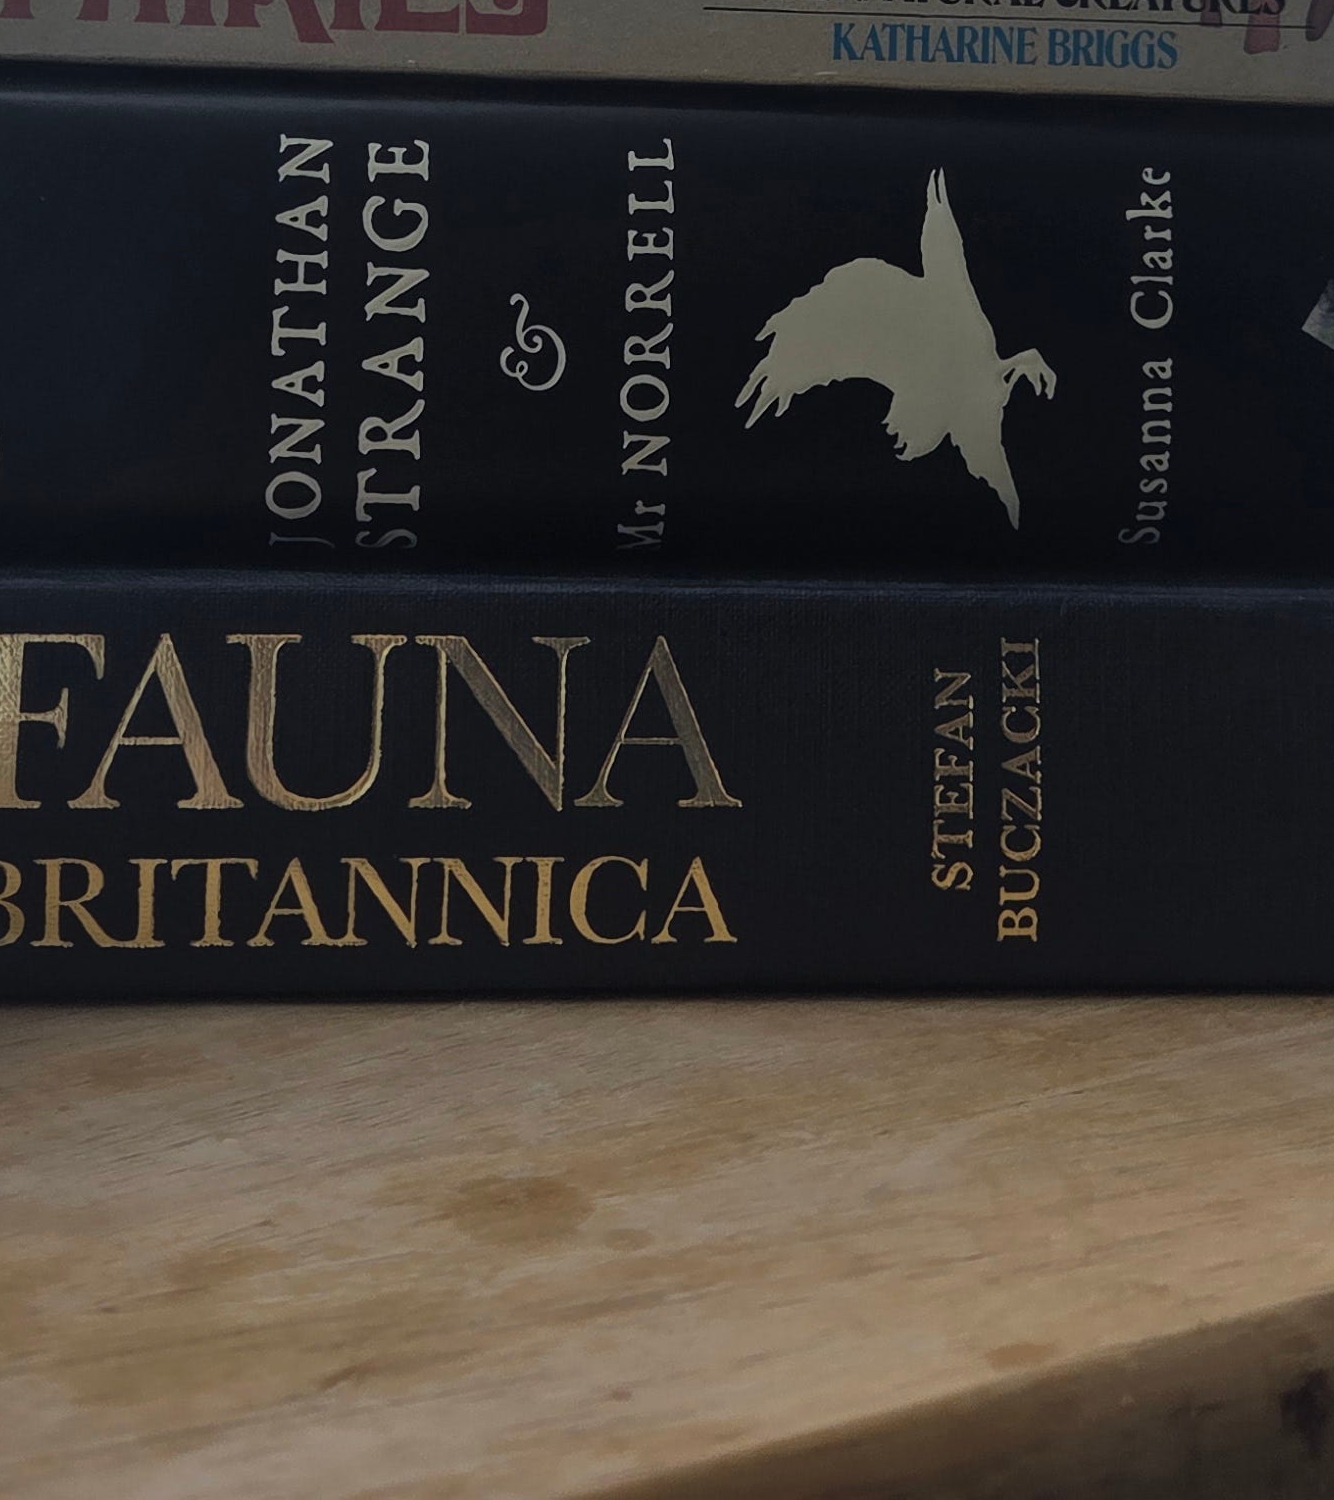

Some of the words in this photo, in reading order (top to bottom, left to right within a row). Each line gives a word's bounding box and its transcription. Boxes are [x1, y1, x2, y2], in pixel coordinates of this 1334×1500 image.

[832, 21, 1038, 67] KATHARINE
[1047, 27, 1179, 70] BRIGGS
[265, 133, 335, 549] JONATHAN
[355, 139, 430, 550] STRANGE
[499, 293, 567, 392] &
[619, 138, 675, 476] NORRELL
[1126, 165, 1174, 330] Clarke
[617, 500, 666, 550] Mr
[1118, 356, 1173, 546] Susanna
[929, 668, 973, 892] STEFAN
[996, 637, 1043, 944] BUCZACKI
